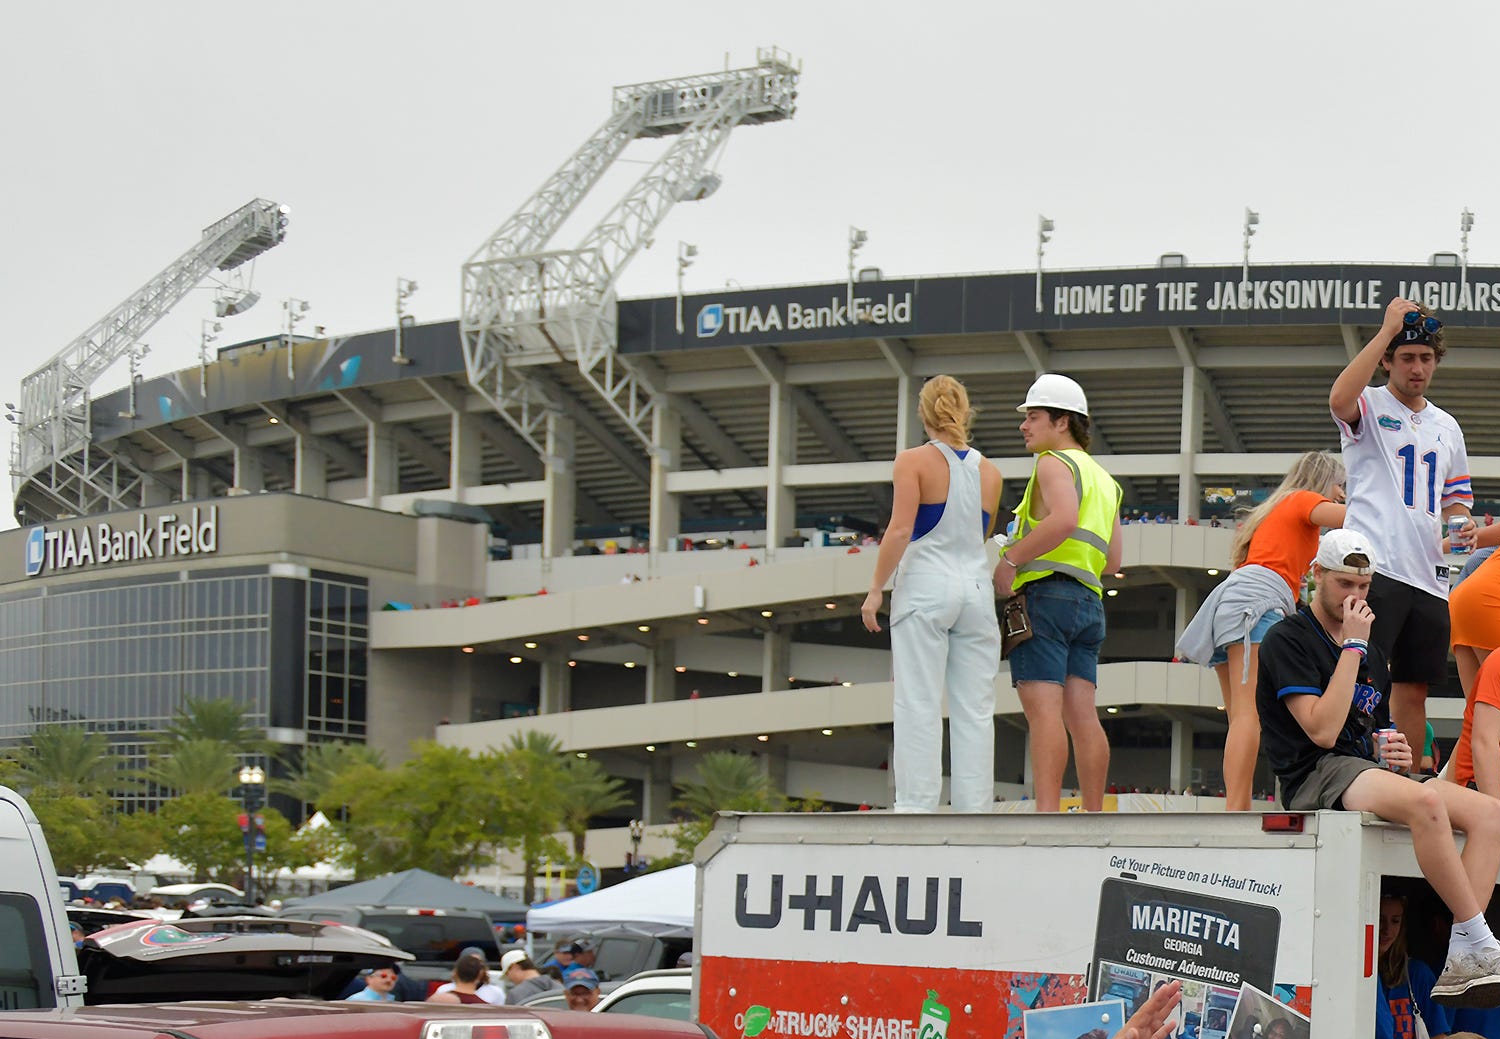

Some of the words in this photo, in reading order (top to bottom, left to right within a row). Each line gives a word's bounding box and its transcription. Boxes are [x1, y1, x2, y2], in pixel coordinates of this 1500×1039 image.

[723, 304, 782, 334] TIAA
[787, 297, 847, 330] Bank
[852, 293, 912, 325] Field
[1054, 285, 1115, 315] HOME
[1119, 283, 1147, 313] OF
[1155, 282, 1198, 312] THE
[1206, 279, 1382, 311] JACKSONVILLE
[1396, 442, 1439, 519] 11
[45, 525, 95, 570] TIAA
[98, 513, 154, 564] Bank
[158, 504, 218, 557] Field
[1109, 855, 1125, 869] Get
[1128, 858, 1150, 873] Your
[1150, 863, 1186, 880] Picture
[1187, 870, 1200, 881] on
[1201, 873, 1208, 884] a
[1210, 873, 1247, 891] U-Haul
[1249, 878, 1282, 897] Truck!
[1131, 904, 1240, 950] MARIETTA
[1163, 938, 1203, 956] GEORGIA
[1126, 948, 1177, 971] Customer
[1177, 959, 1240, 984] Adventures
[775, 1010, 841, 1037] TRUCK
